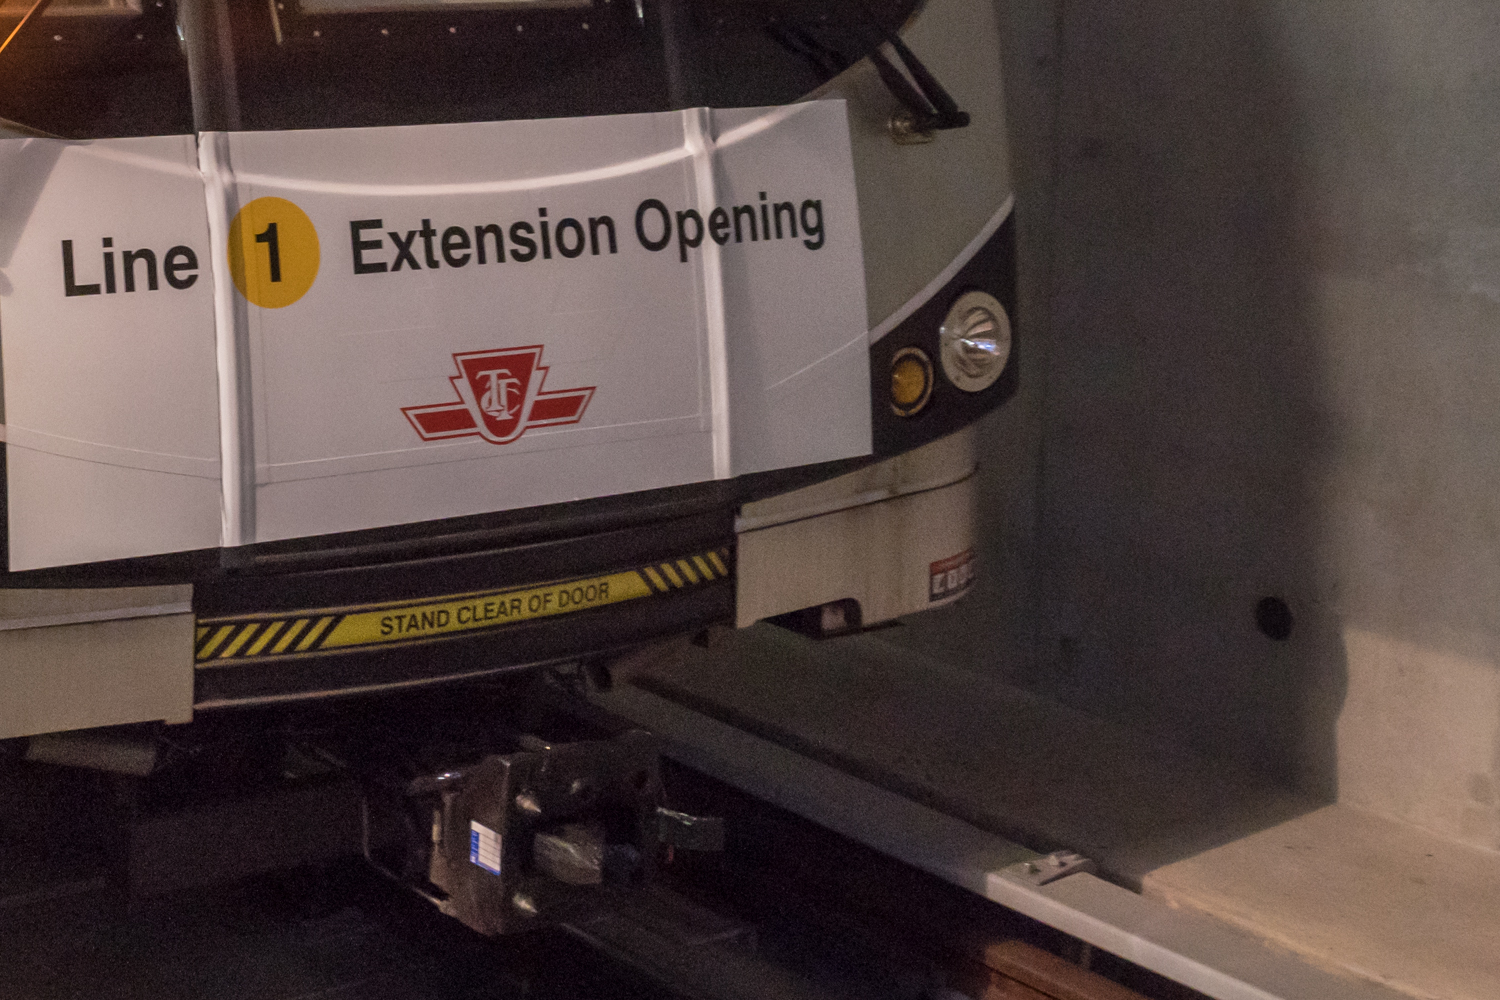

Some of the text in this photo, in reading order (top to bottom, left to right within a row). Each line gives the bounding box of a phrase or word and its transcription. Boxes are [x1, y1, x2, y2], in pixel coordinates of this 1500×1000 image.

[60, 191, 825, 297] Line 1 Extension Opening
[380, 582, 610, 636] STAND CLEAR OF DOOR
